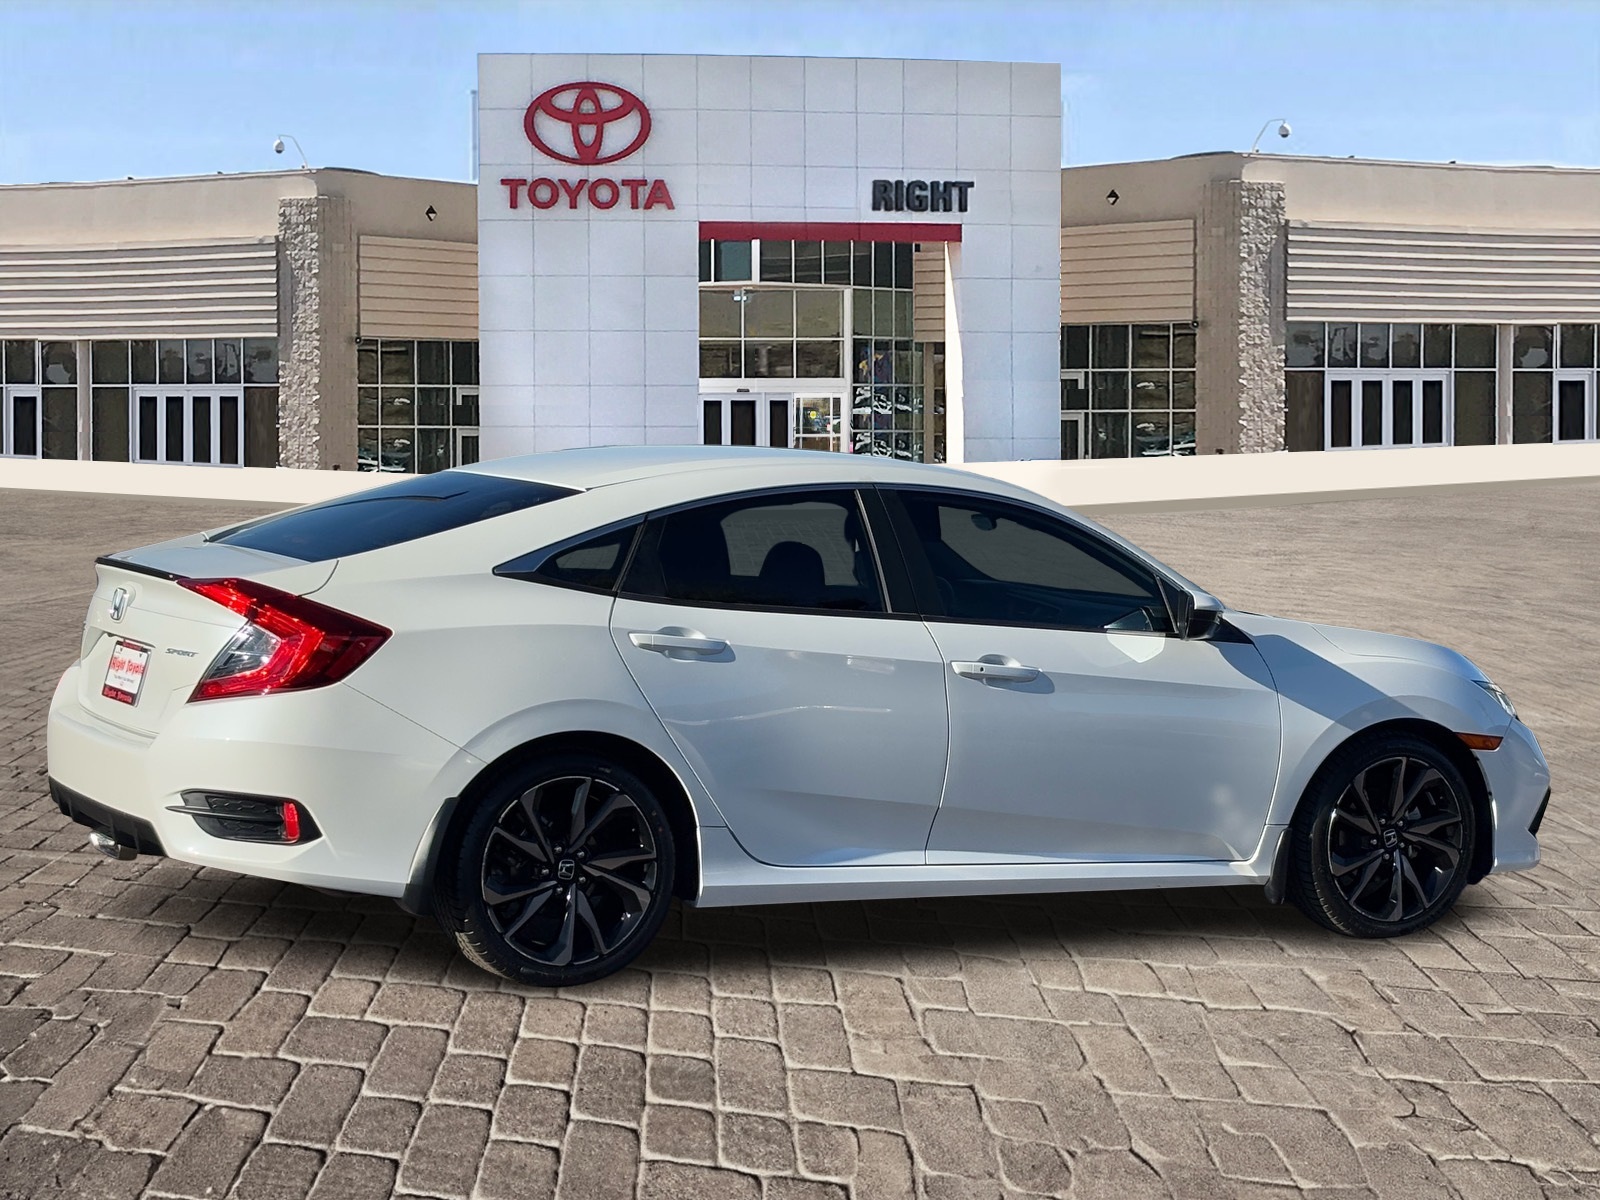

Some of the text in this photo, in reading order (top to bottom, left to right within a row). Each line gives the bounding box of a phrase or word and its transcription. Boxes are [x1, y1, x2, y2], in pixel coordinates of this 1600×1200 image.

[500, 177, 675, 210] TOYOTA
[872, 179, 975, 212] RIGHT
[165, 648, 199, 657] SPORT
